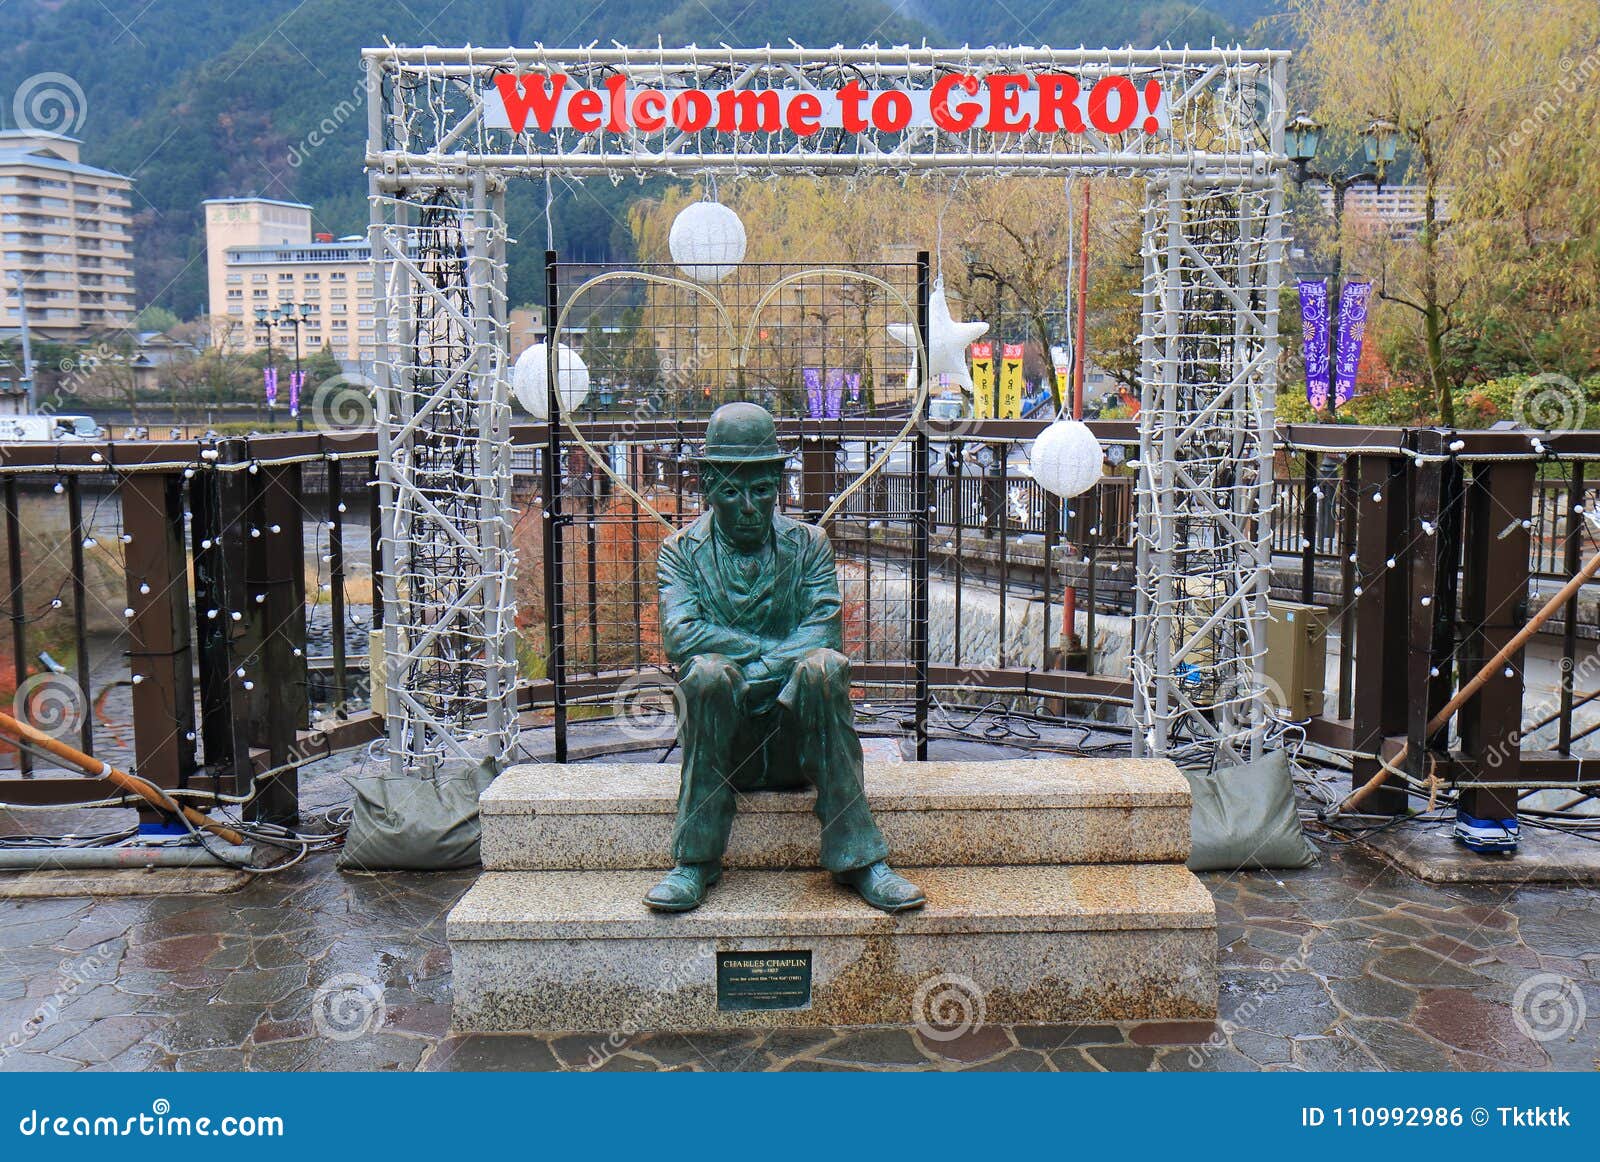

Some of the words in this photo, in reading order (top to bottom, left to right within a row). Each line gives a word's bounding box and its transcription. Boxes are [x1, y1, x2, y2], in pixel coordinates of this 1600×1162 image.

[493, 73, 822, 136] Welcome
[836, 79, 912, 135] to
[929, 73, 1162, 135] GERO!
[723, 960, 764, 968] CHARLES
[766, 959, 806, 967] CHAPLIN
